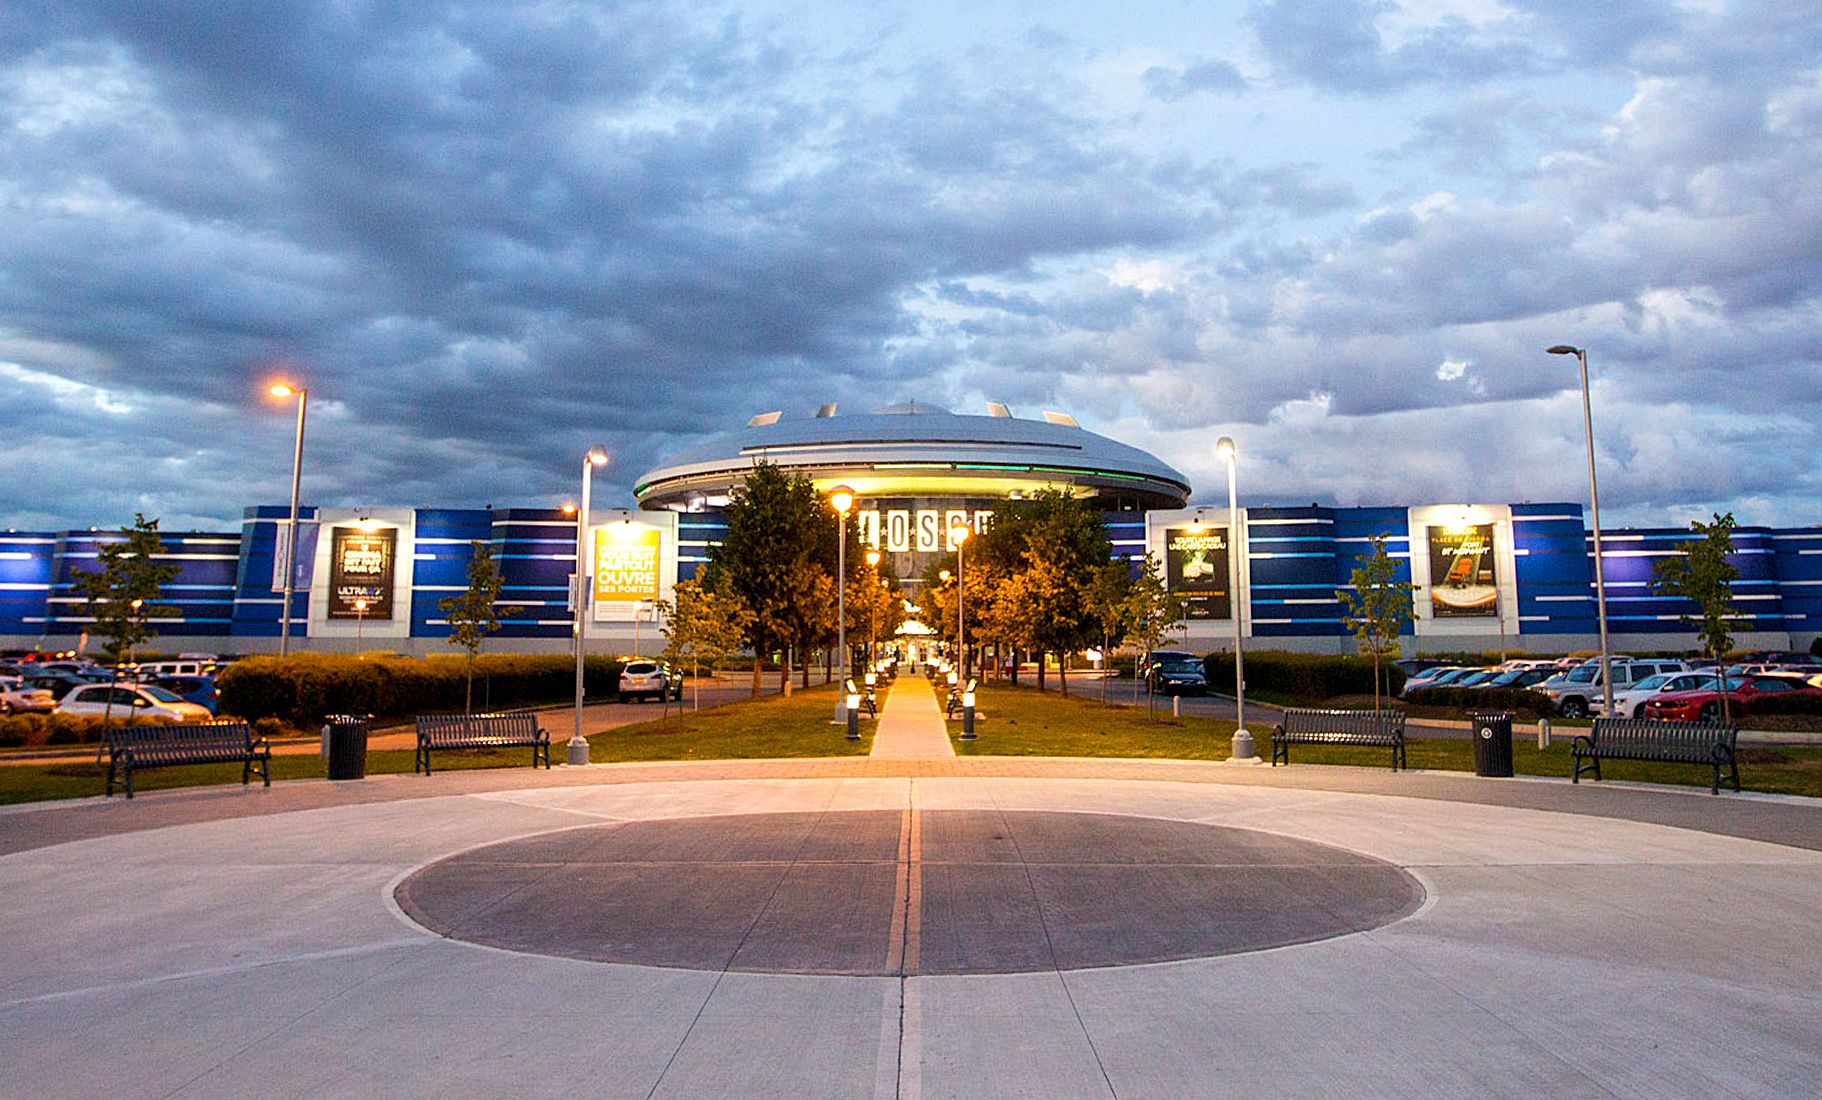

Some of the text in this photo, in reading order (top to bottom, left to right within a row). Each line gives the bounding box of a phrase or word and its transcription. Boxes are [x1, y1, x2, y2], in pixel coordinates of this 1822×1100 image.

[598, 571, 655, 585] OUVRE
[598, 585, 655, 593] SES PORTES
